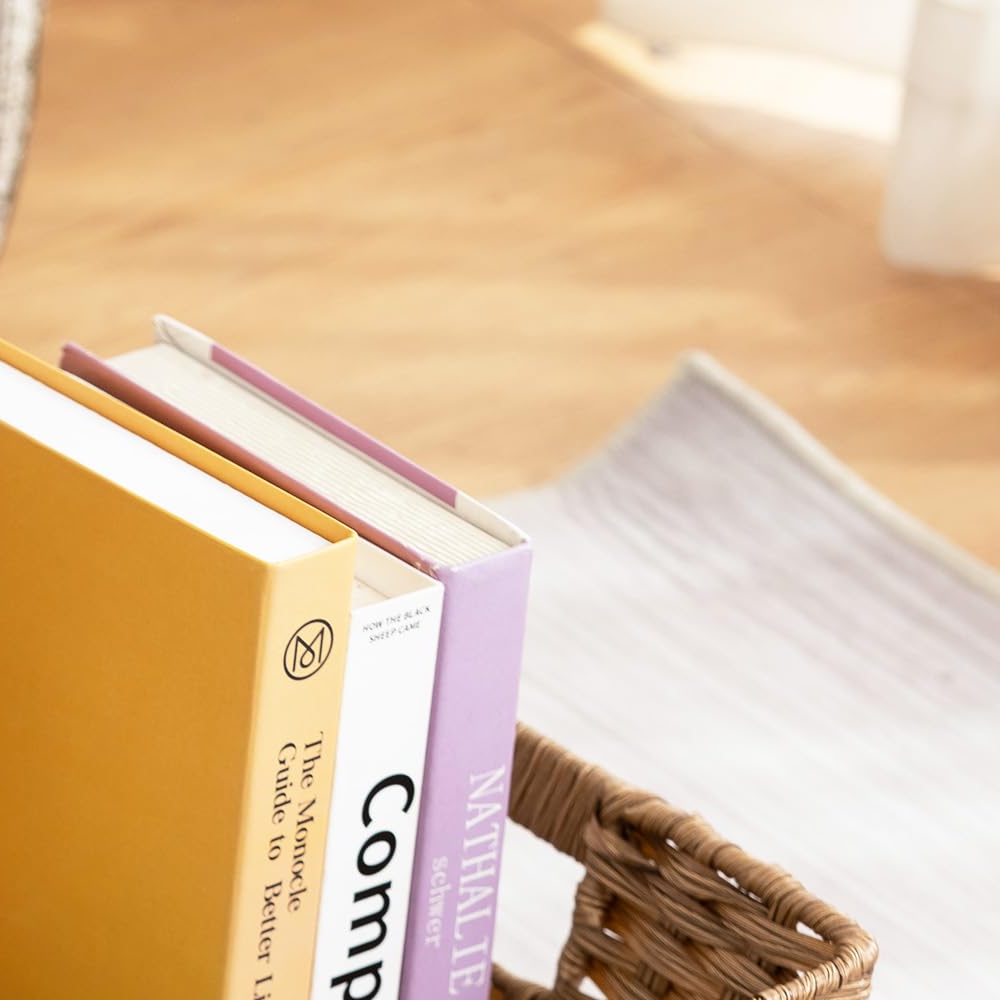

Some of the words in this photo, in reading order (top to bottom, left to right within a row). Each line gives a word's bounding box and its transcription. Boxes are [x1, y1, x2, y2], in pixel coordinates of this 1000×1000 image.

[271, 742, 297, 825] Guide
[300, 730, 324, 790] The
[267, 834, 286, 861] to
[287, 796, 316, 913] Monocle
[448, 764, 506, 996] NATHALIE
[257, 880, 283, 964] Better
